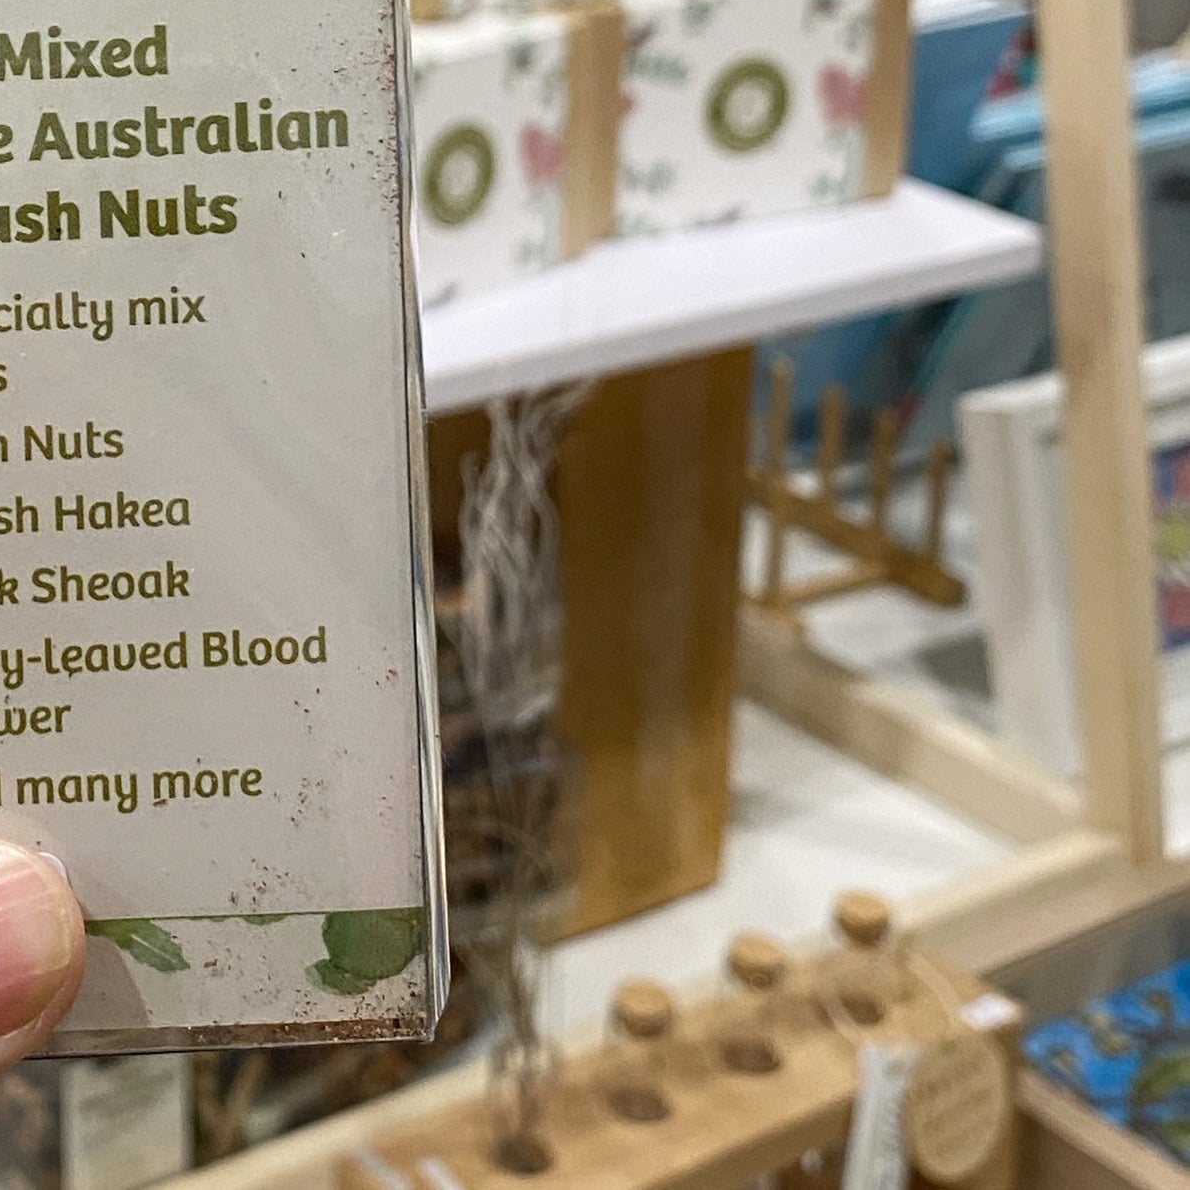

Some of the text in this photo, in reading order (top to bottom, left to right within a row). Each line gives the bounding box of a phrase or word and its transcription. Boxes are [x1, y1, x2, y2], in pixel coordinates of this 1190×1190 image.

[31, 98, 347, 161] Australian
[100, 186, 237, 237] Nuts
[129, 286, 206, 324] mix
[24, 421, 123, 460] Nuts
[55, 492, 188, 531] Hakea
[33, 560, 188, 603] Sheoak
[203, 628, 326, 667] Blood
[17, 774, 138, 814] many
[152, 768, 262, 800] more
